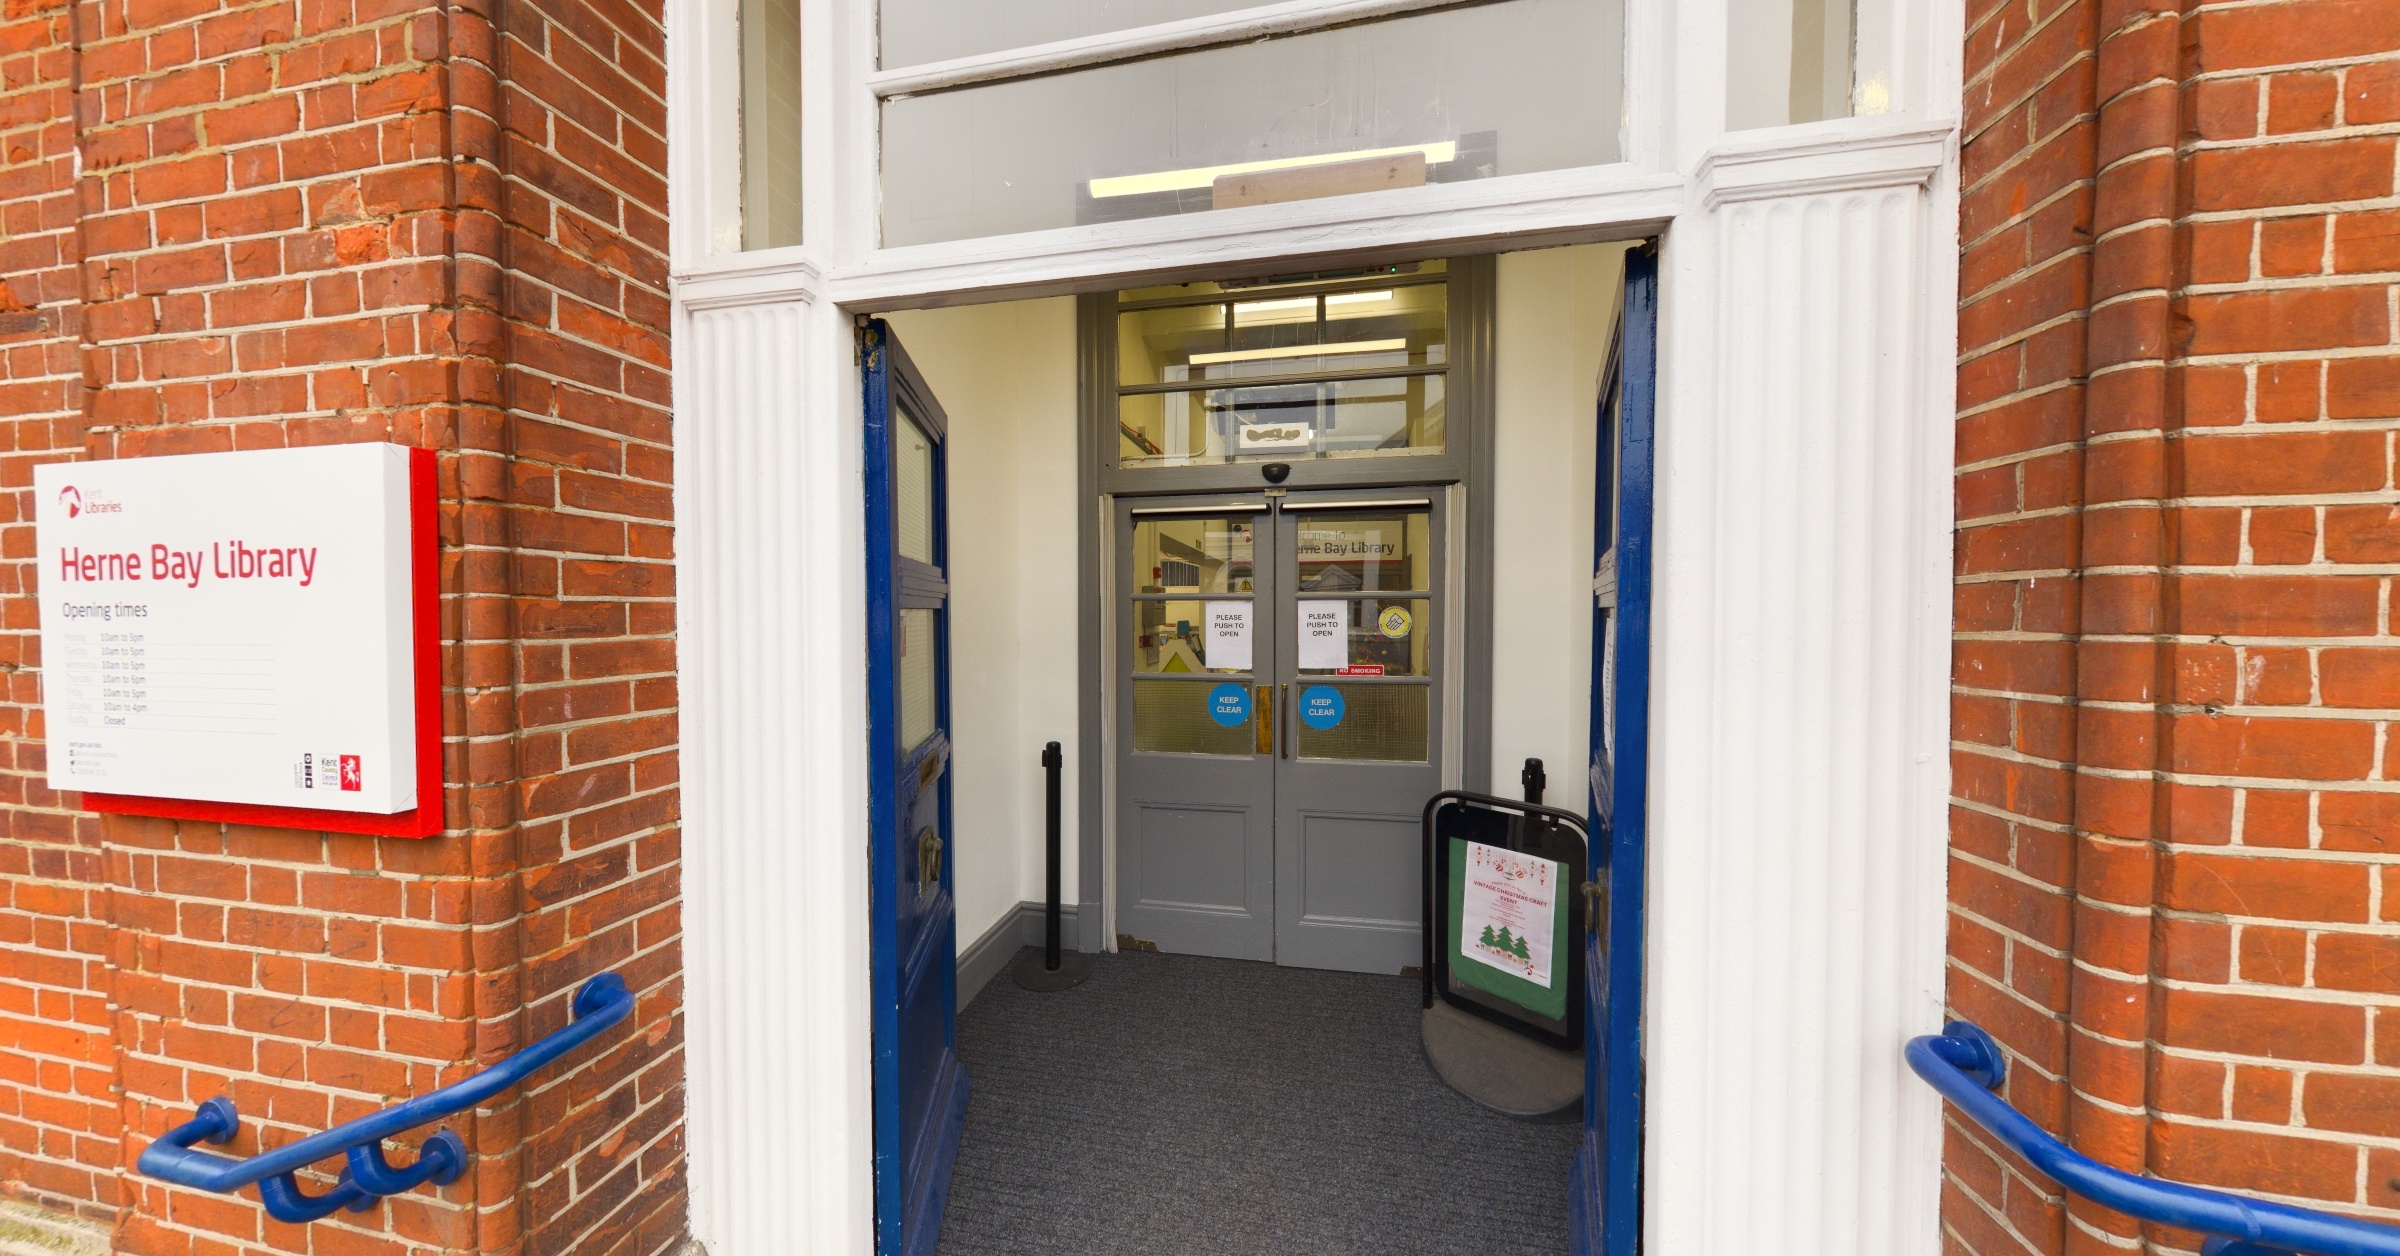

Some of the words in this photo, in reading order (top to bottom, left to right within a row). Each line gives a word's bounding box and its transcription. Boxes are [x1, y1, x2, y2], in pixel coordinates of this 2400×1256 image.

[85, 501, 122, 514] Libraries
[1335, 530, 1345, 541] to
[1324, 542, 1347, 556] Bay
[1351, 541, 1395, 556] Library
[61, 546, 141, 582] Herne
[151, 543, 203, 589] Bay
[213, 540, 317, 587] Library
[62, 602, 111, 621] Opening
[115, 601, 148, 618] times
[121, 633, 128, 642] to
[121, 647, 128, 656] to
[122, 661, 129, 670] to
[122, 675, 129, 683] to
[123, 689, 130, 697] to
[1311, 698, 1332, 706] KEEP
[124, 703, 131, 711] to
[1216, 706, 1242, 714] CLEAR
[1308, 708, 1335, 716] CLEAR
[104, 715, 126, 725] Closed
[321, 757, 337, 767] Kent
[1473, 880, 1496, 892] VINTAGE
[1497, 887, 1529, 902] CHRISTMAS
[1529, 897, 1548, 907] CRAFT
[1500, 895, 1518, 905] EVENT
